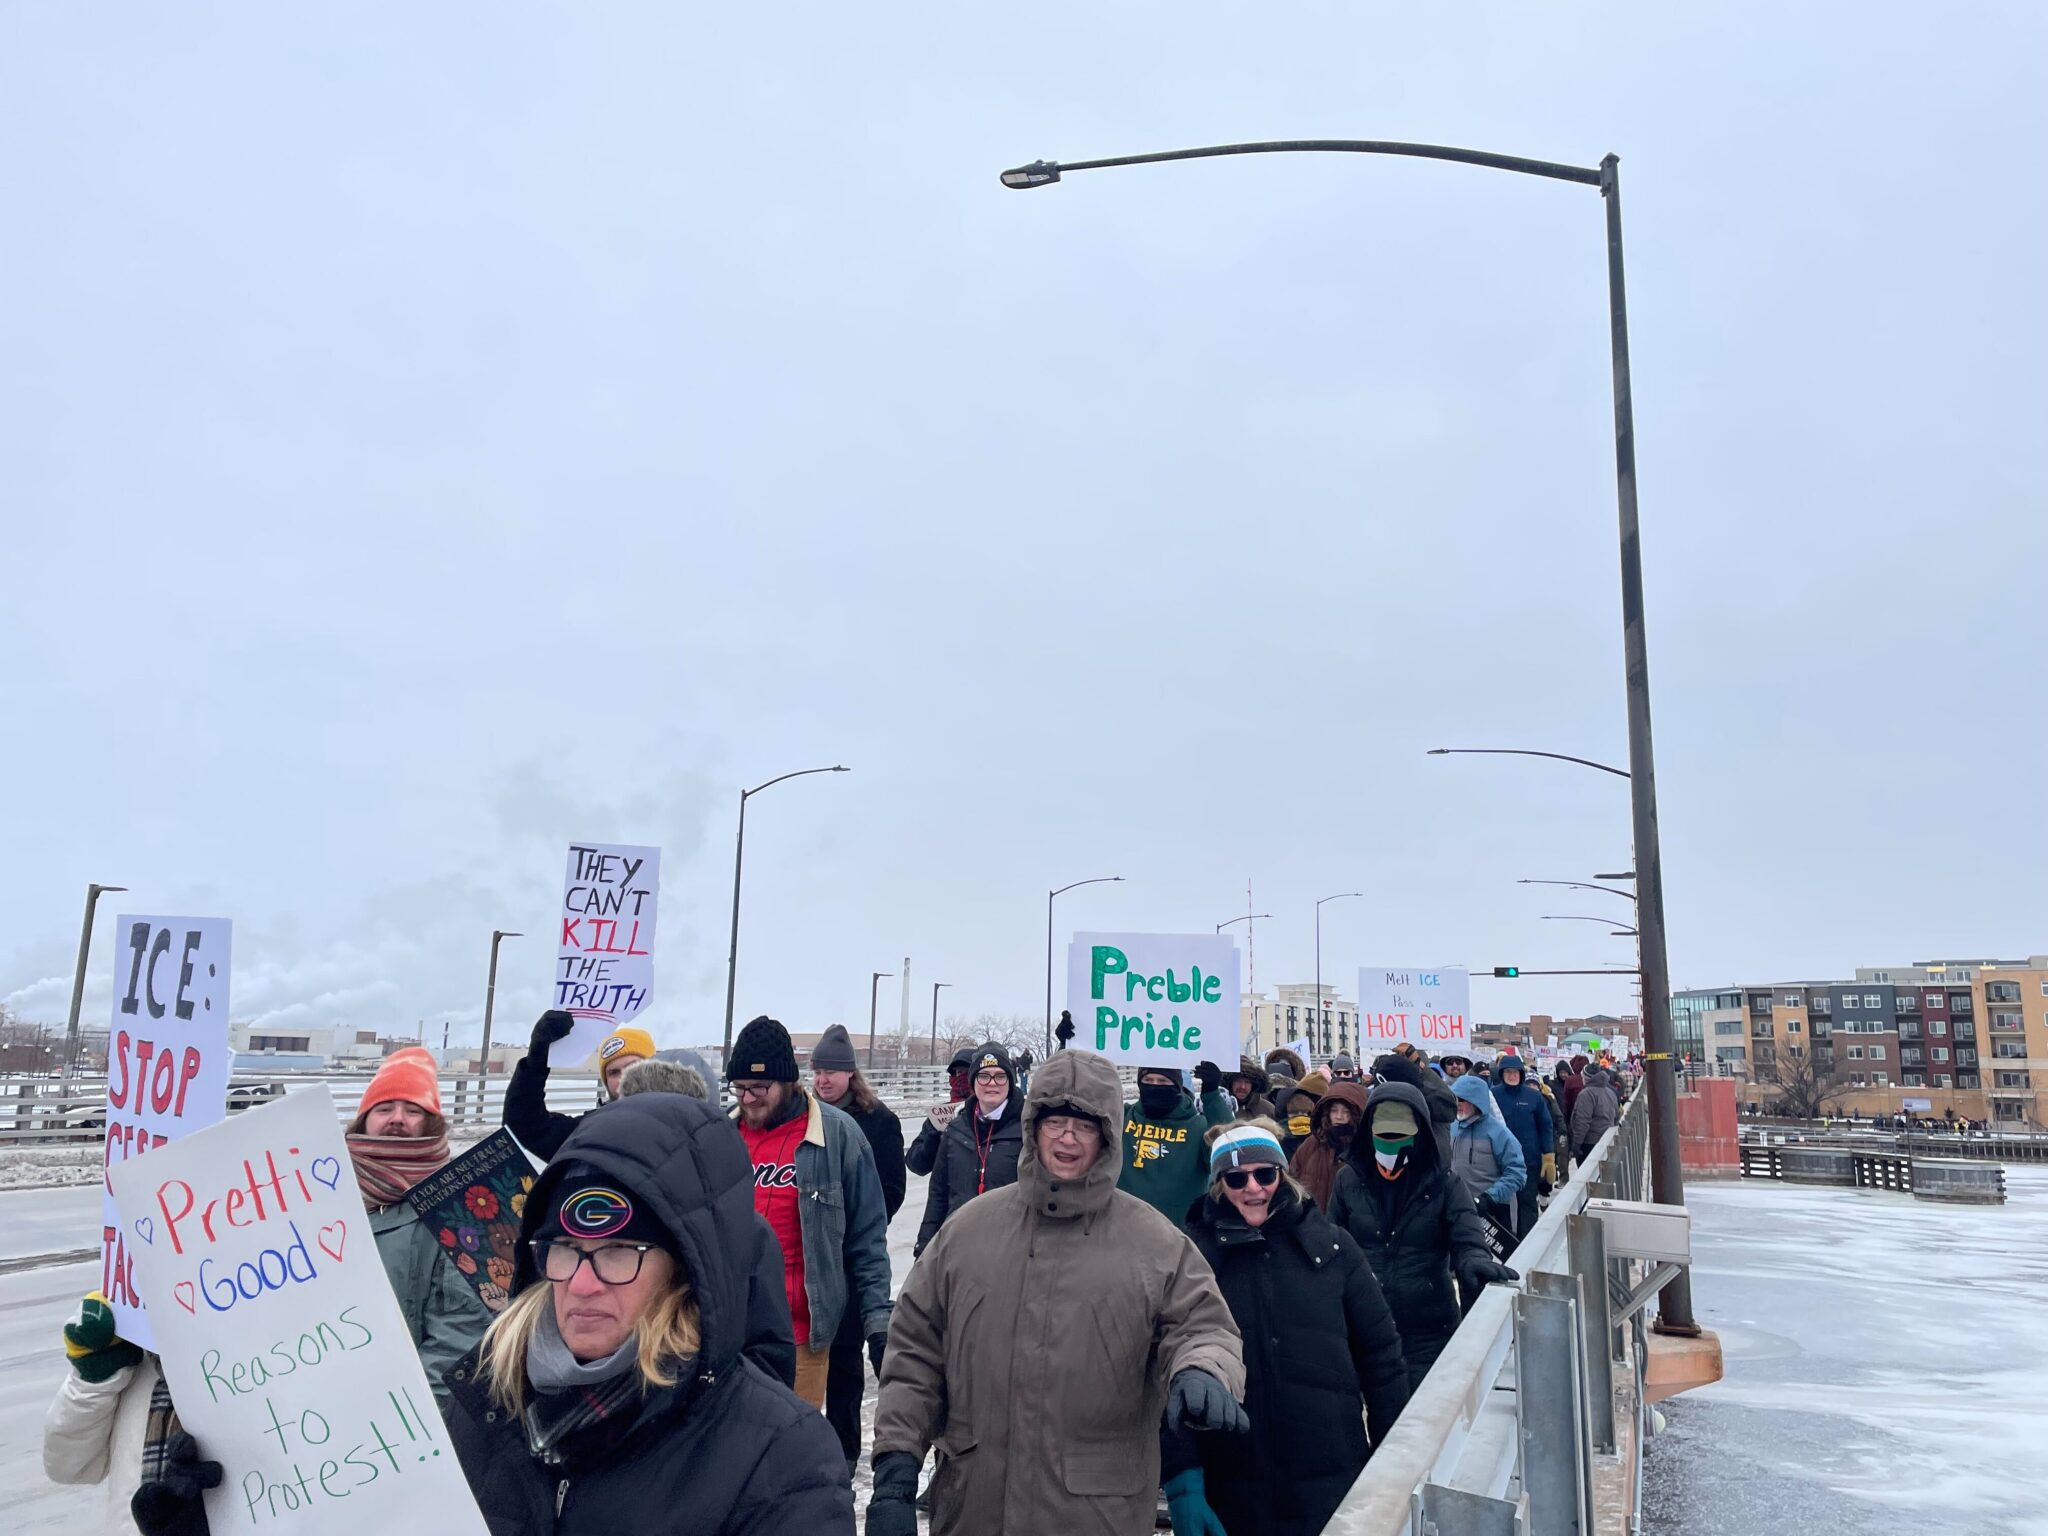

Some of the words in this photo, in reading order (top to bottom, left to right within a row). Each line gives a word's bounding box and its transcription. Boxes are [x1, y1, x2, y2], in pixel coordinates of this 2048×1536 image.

[569, 846, 643, 888] THEY
[566, 886, 651, 916] CAN'T
[562, 917, 649, 955] KILL
[121, 922, 216, 1021] ICE:
[556, 981, 647, 1013] TRUTH
[558, 956, 620, 982] THE
[1091, 945, 1222, 1003] Preble
[1386, 972, 1409, 986] Melt
[1420, 974, 1441, 986] ICE
[1096, 1006, 1201, 1051] Pride
[1366, 1013, 1409, 1039] HOT
[1420, 1014, 1464, 1039] DISH
[1393, 994, 1414, 1008] Pass
[109, 1030, 201, 1118] STOP
[416, 1178, 464, 1214] SITUATIONS
[461, 1171, 475, 1185] OF
[474, 1145, 517, 1177] INJUSTICE
[418, 1180, 440, 1198] YOU
[439, 1169, 456, 1186] ARE
[455, 1144, 497, 1175] NEUTRAL
[495, 1135, 509, 1147] IN
[156, 1147, 313, 1254] Pretti
[199, 1219, 317, 1312] Good
[200, 1305, 372, 1403] Reasons
[263, 1397, 330, 1454] to
[242, 1386, 440, 1524] Protest!!
